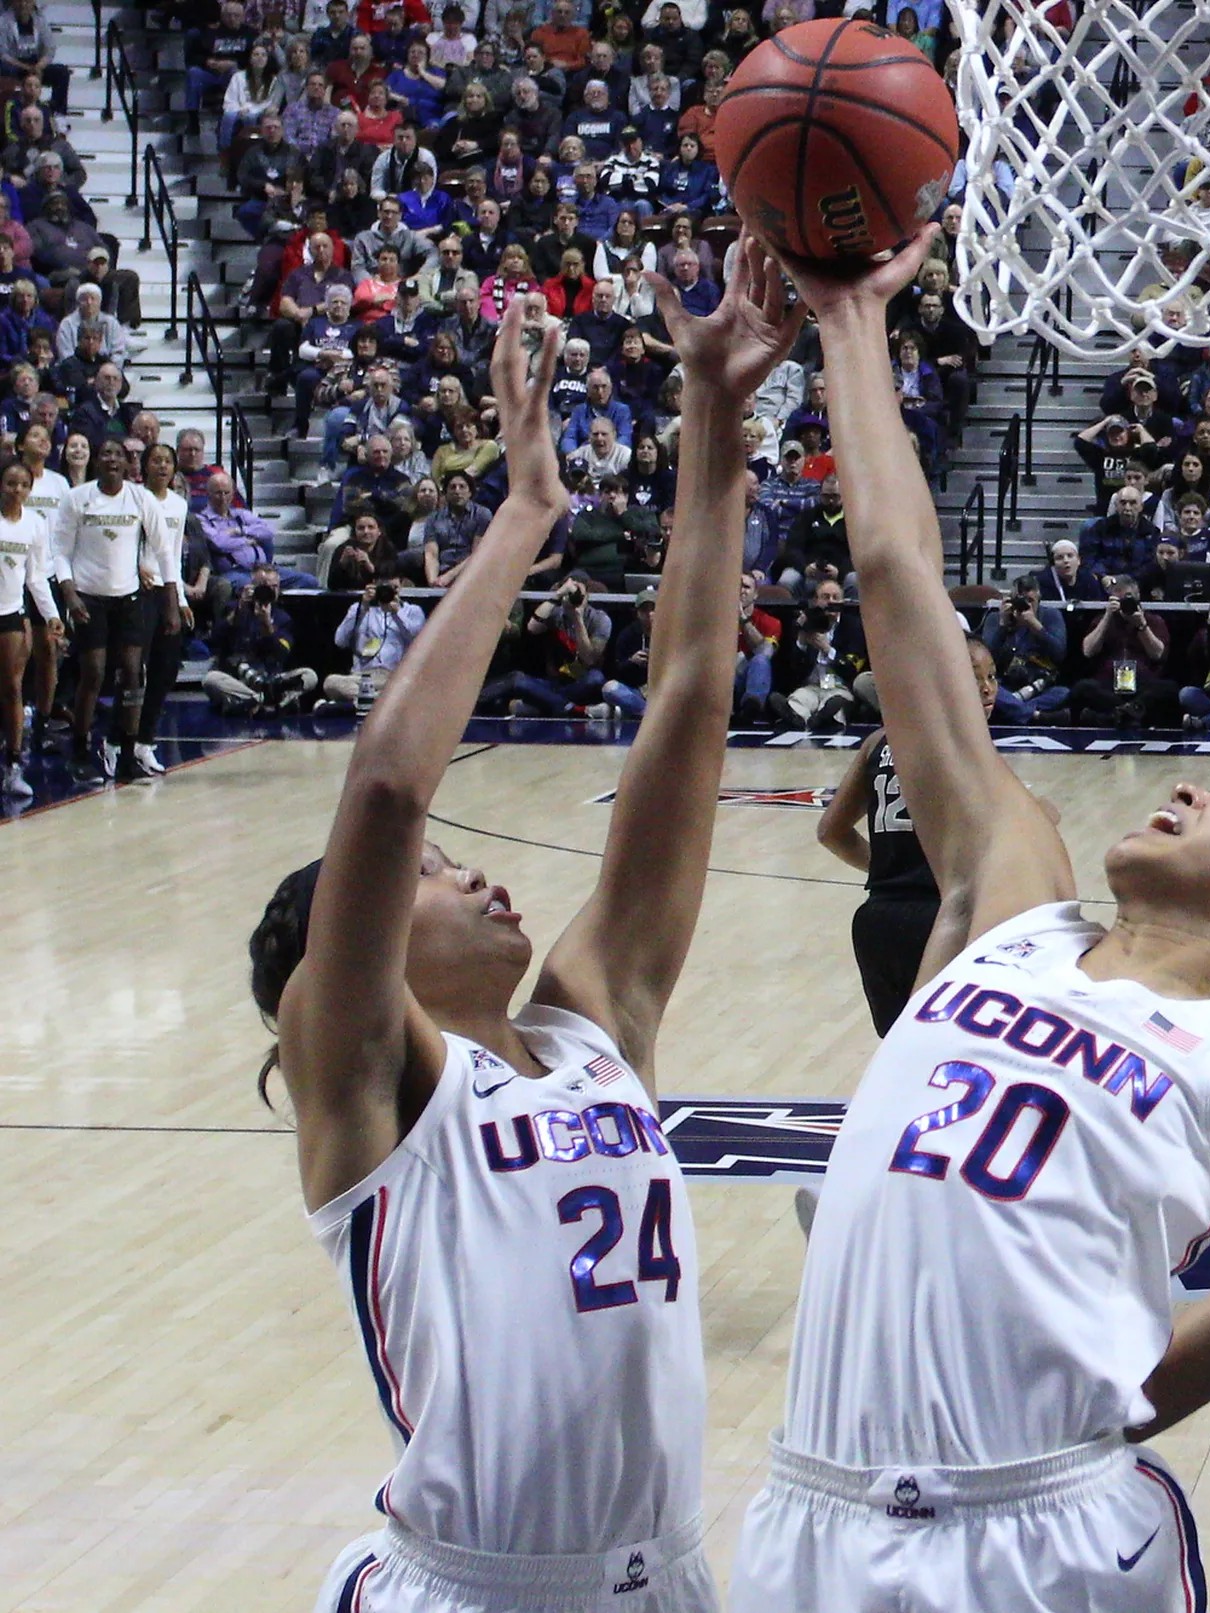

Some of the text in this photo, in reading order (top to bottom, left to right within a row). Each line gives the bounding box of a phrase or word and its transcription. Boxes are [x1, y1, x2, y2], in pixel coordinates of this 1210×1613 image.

[553, 379, 587, 393] UCON
[914, 981, 1174, 1123] UCONN
[888, 1060, 1071, 1202] 20
[557, 1179, 681, 1313] 24
[613, 1576, 649, 1594] UCONN
